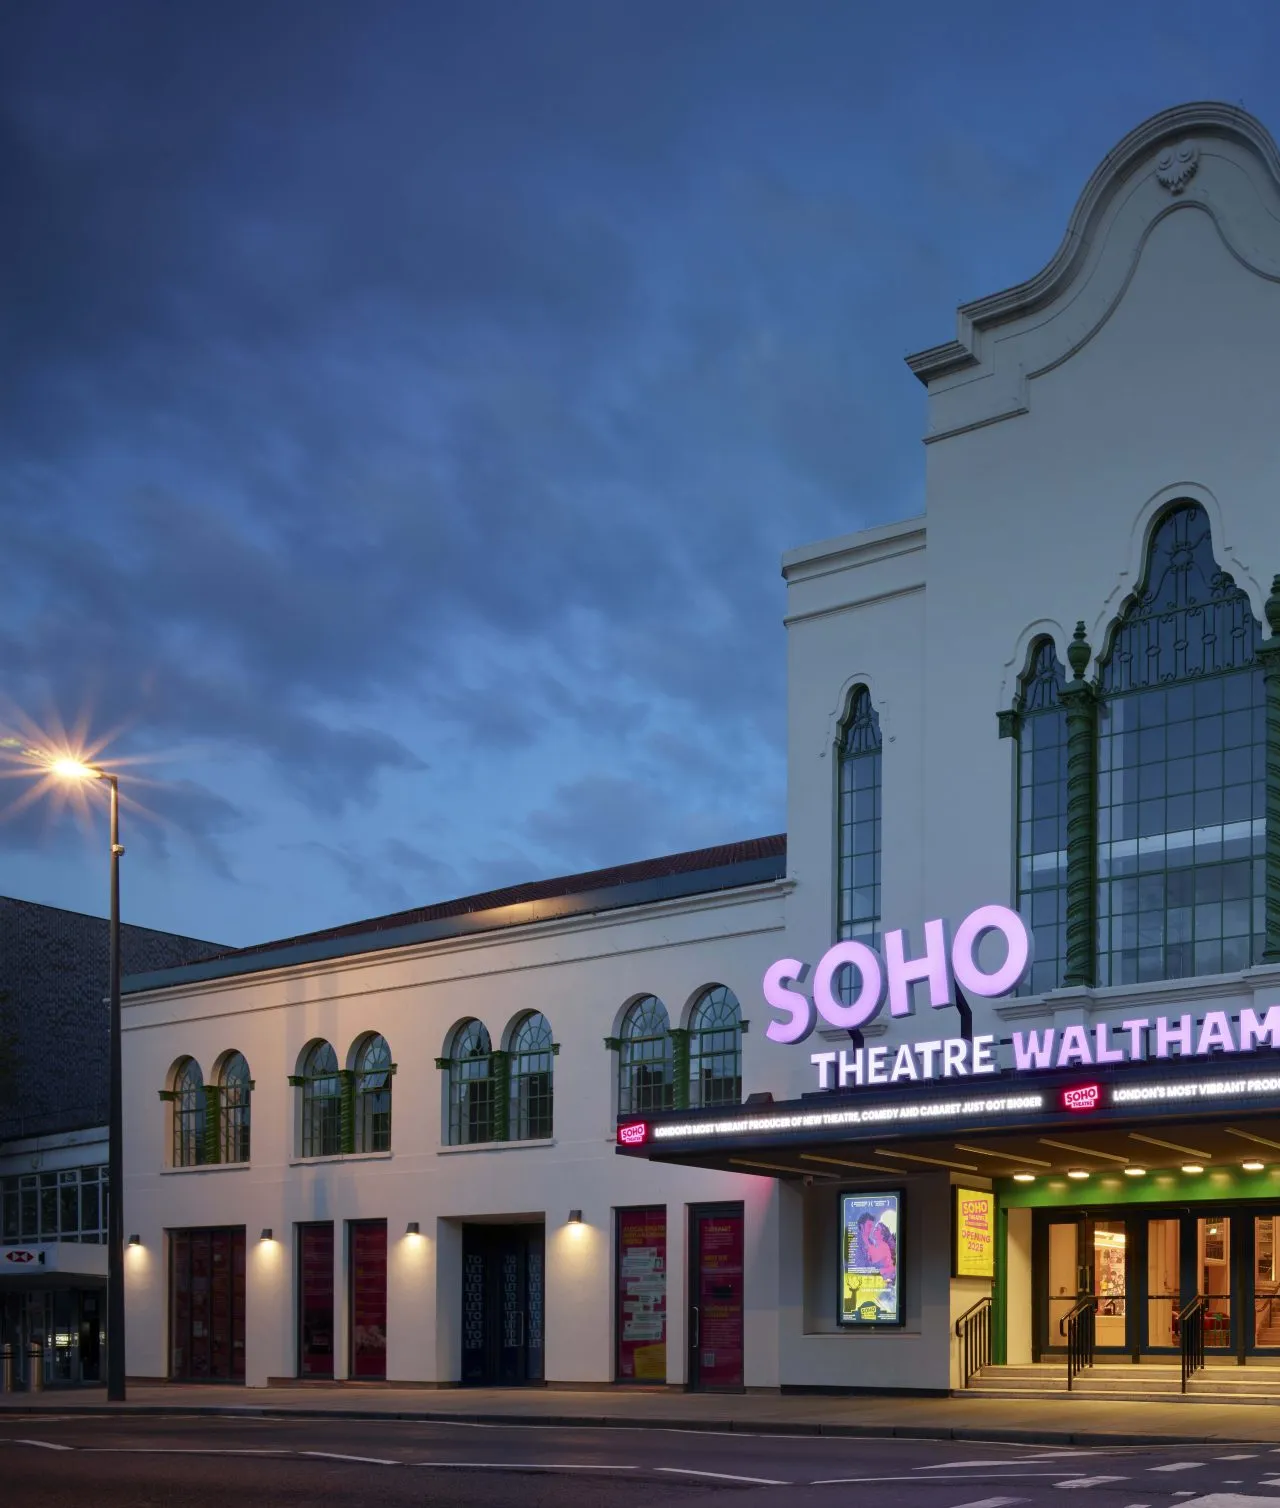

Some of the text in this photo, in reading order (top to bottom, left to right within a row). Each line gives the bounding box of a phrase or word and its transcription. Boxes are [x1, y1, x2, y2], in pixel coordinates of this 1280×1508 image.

[763, 904, 1034, 1045] SOHO
[811, 1035, 995, 1090] THEATRE
[1067, 1089, 1096, 1103] SOHO
[1113, 1086, 1165, 1101] LONDON'S
[1167, 1085, 1197, 1097] MOST
[1198, 1081, 1247, 1095] VIBRANT
[655, 1097, 1042, 1137] LONDON'S MOST VIBRANT PRODUCER OF NEW THEATRE, COMEDY AND CABARET JUST GOT BIGGER
[623, 1127, 643, 1138] SOHO
[963, 1202, 988, 1214] SOHO
[961, 1230, 991, 1243] OPENING
[967, 1241, 983, 1252] 2025
[467, 1254, 482, 1264] TO
[465, 1264, 484, 1273] LET
[467, 1273, 482, 1283] TO
[465, 1282, 484, 1292] LET
[467, 1292, 482, 1302] TO
[465, 1301, 484, 1311] LET
[467, 1312, 482, 1320] TO
[465, 1321, 484, 1330] LET
[467, 1330, 482, 1339] TO
[465, 1339, 484, 1349] LET
